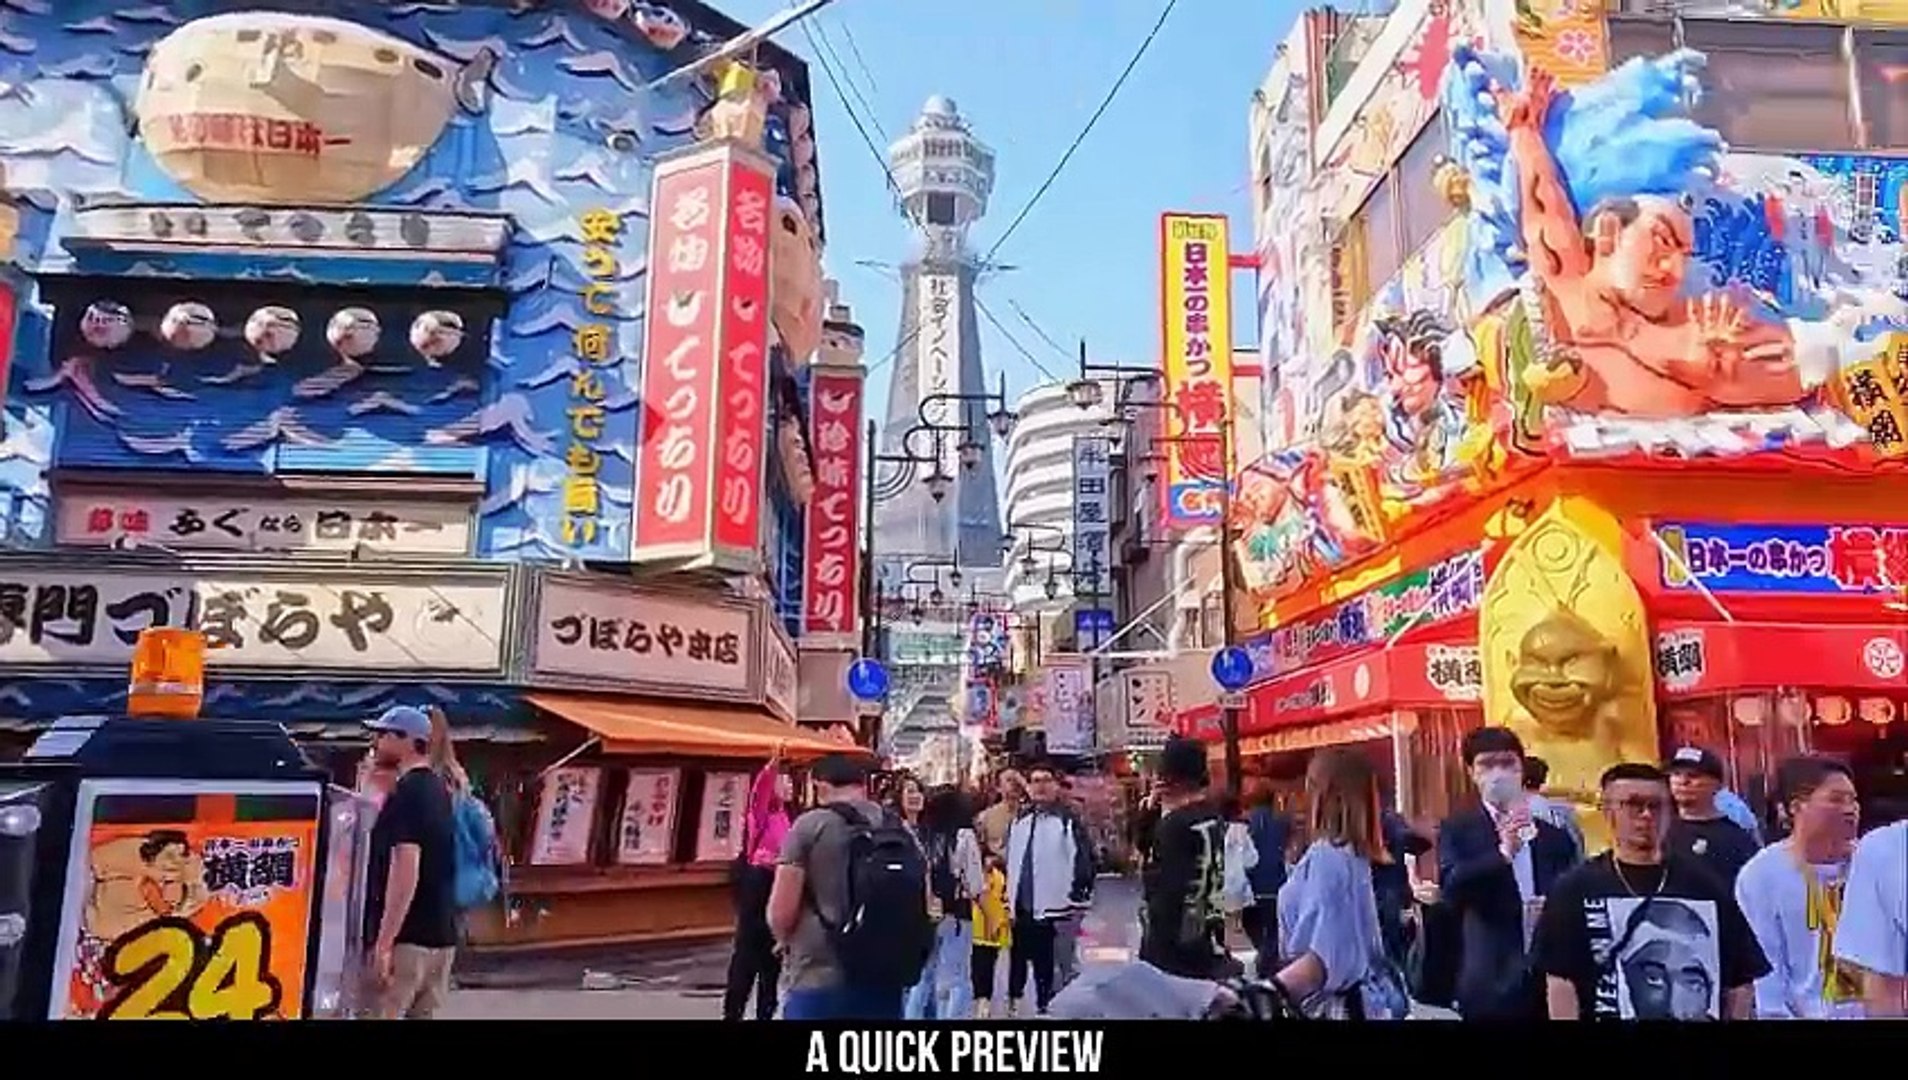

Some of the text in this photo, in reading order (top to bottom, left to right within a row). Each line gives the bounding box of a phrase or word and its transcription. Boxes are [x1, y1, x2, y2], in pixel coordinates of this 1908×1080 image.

[551, 614, 739, 665] づぼらや本店
[203, 851, 294, 892] 横綱
[1584, 898, 1607, 928] ME
[103, 910, 283, 1021] 24
[1594, 972, 1617, 1021] YEZ
